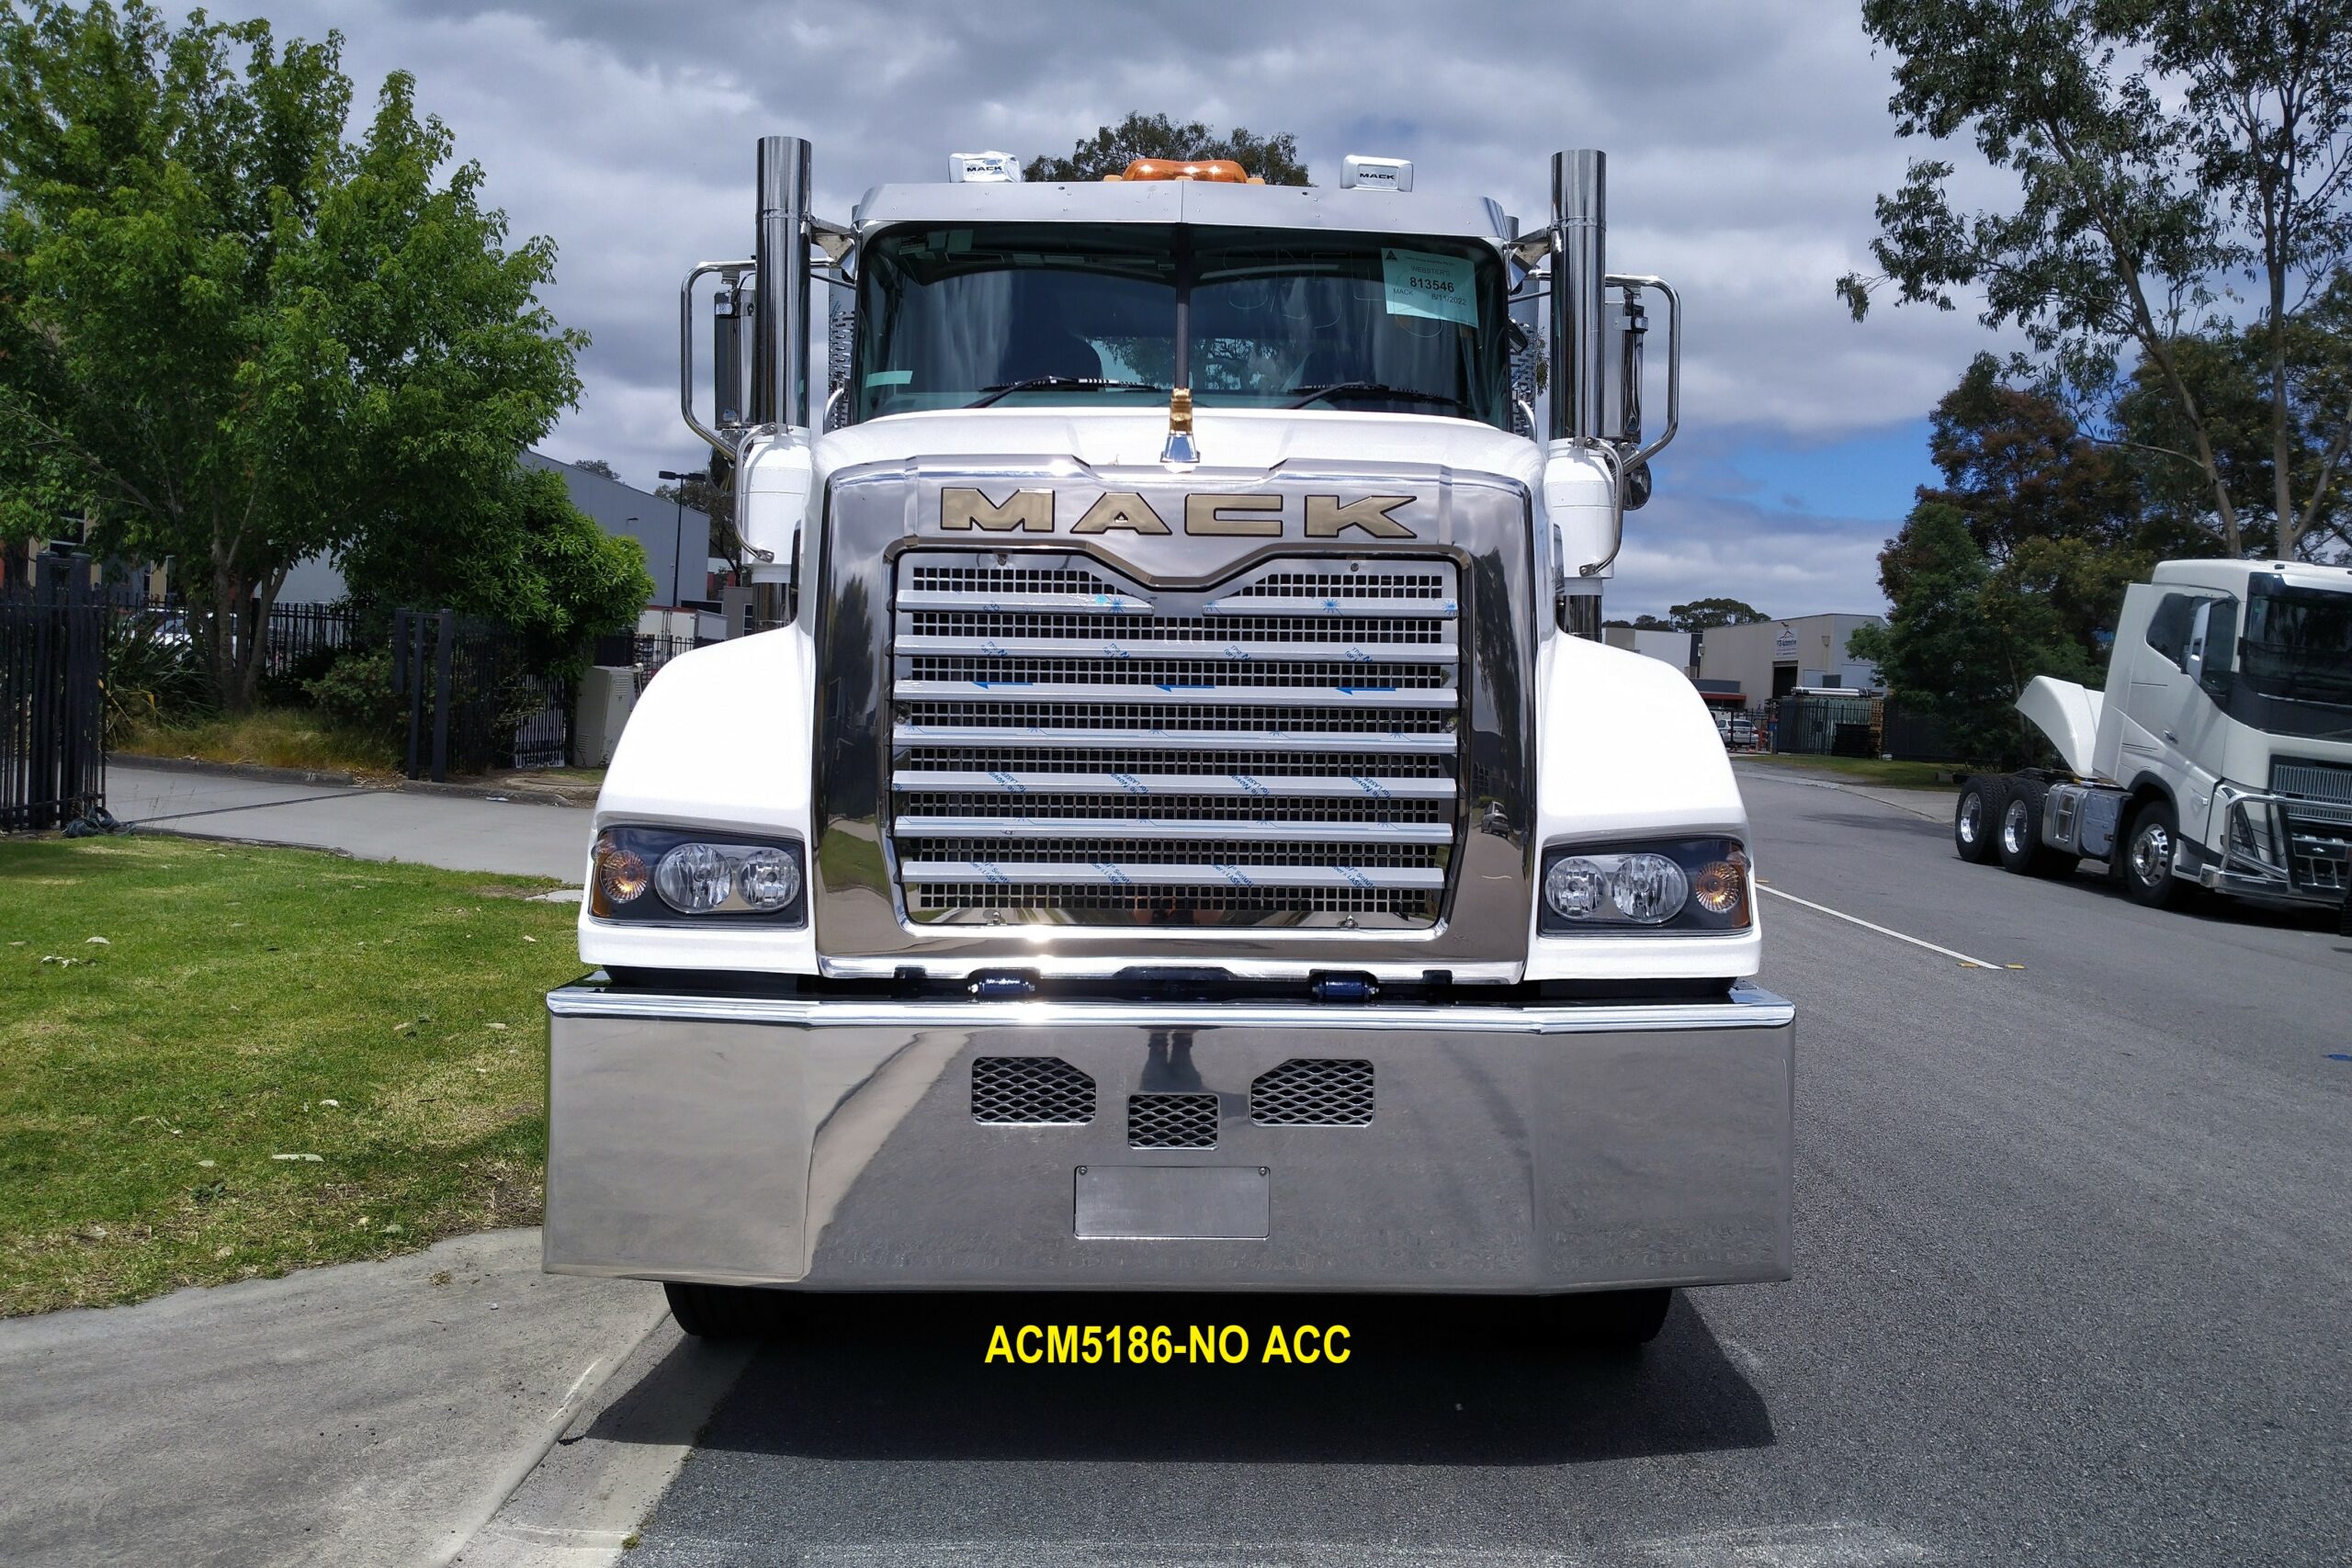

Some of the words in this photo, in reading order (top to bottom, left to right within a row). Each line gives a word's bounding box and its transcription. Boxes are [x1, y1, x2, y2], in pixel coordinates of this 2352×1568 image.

[966, 165, 1003, 175] MACK
[1359, 171, 1396, 181] MACK
[1409, 276, 1455, 293] 813546
[1393, 288, 1415, 297] MACK
[1430, 293, 1467, 306] 8/11/2022
[940, 487, 1418, 539] MACK
